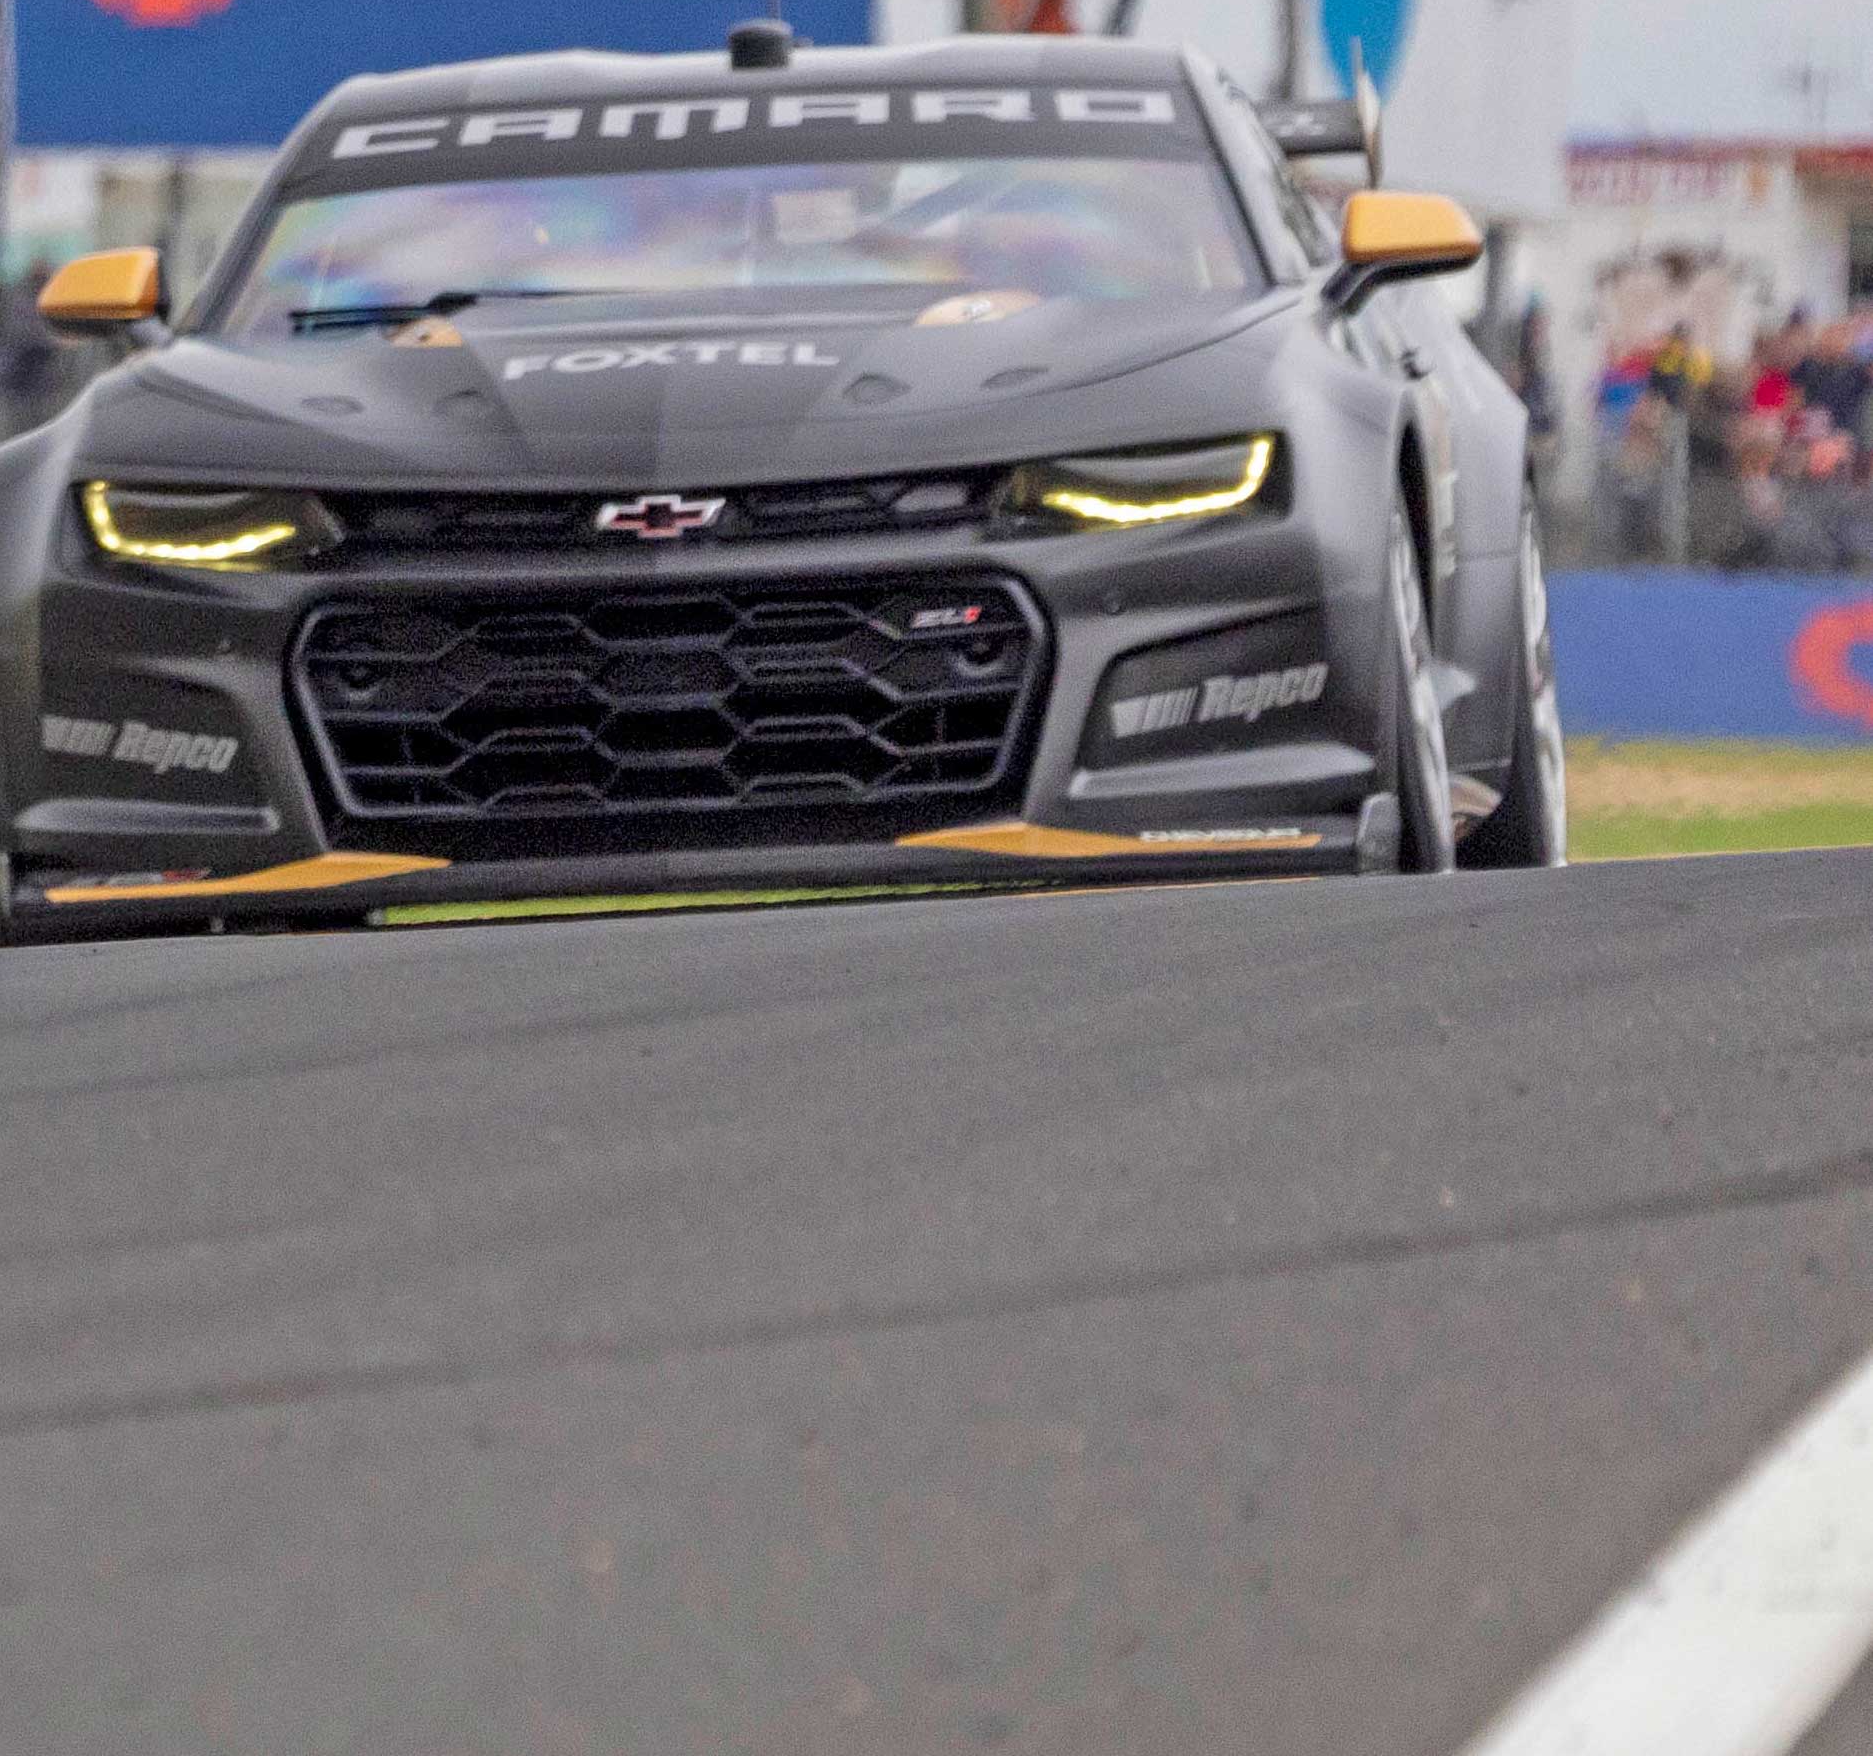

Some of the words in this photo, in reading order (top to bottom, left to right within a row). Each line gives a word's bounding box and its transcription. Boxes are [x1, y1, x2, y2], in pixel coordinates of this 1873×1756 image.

[332, 90, 1176, 159] CAMARO
[504, 341, 842, 381] FOXTEL
[1197, 661, 1329, 723] Repco
[113, 716, 239, 775] Repco
